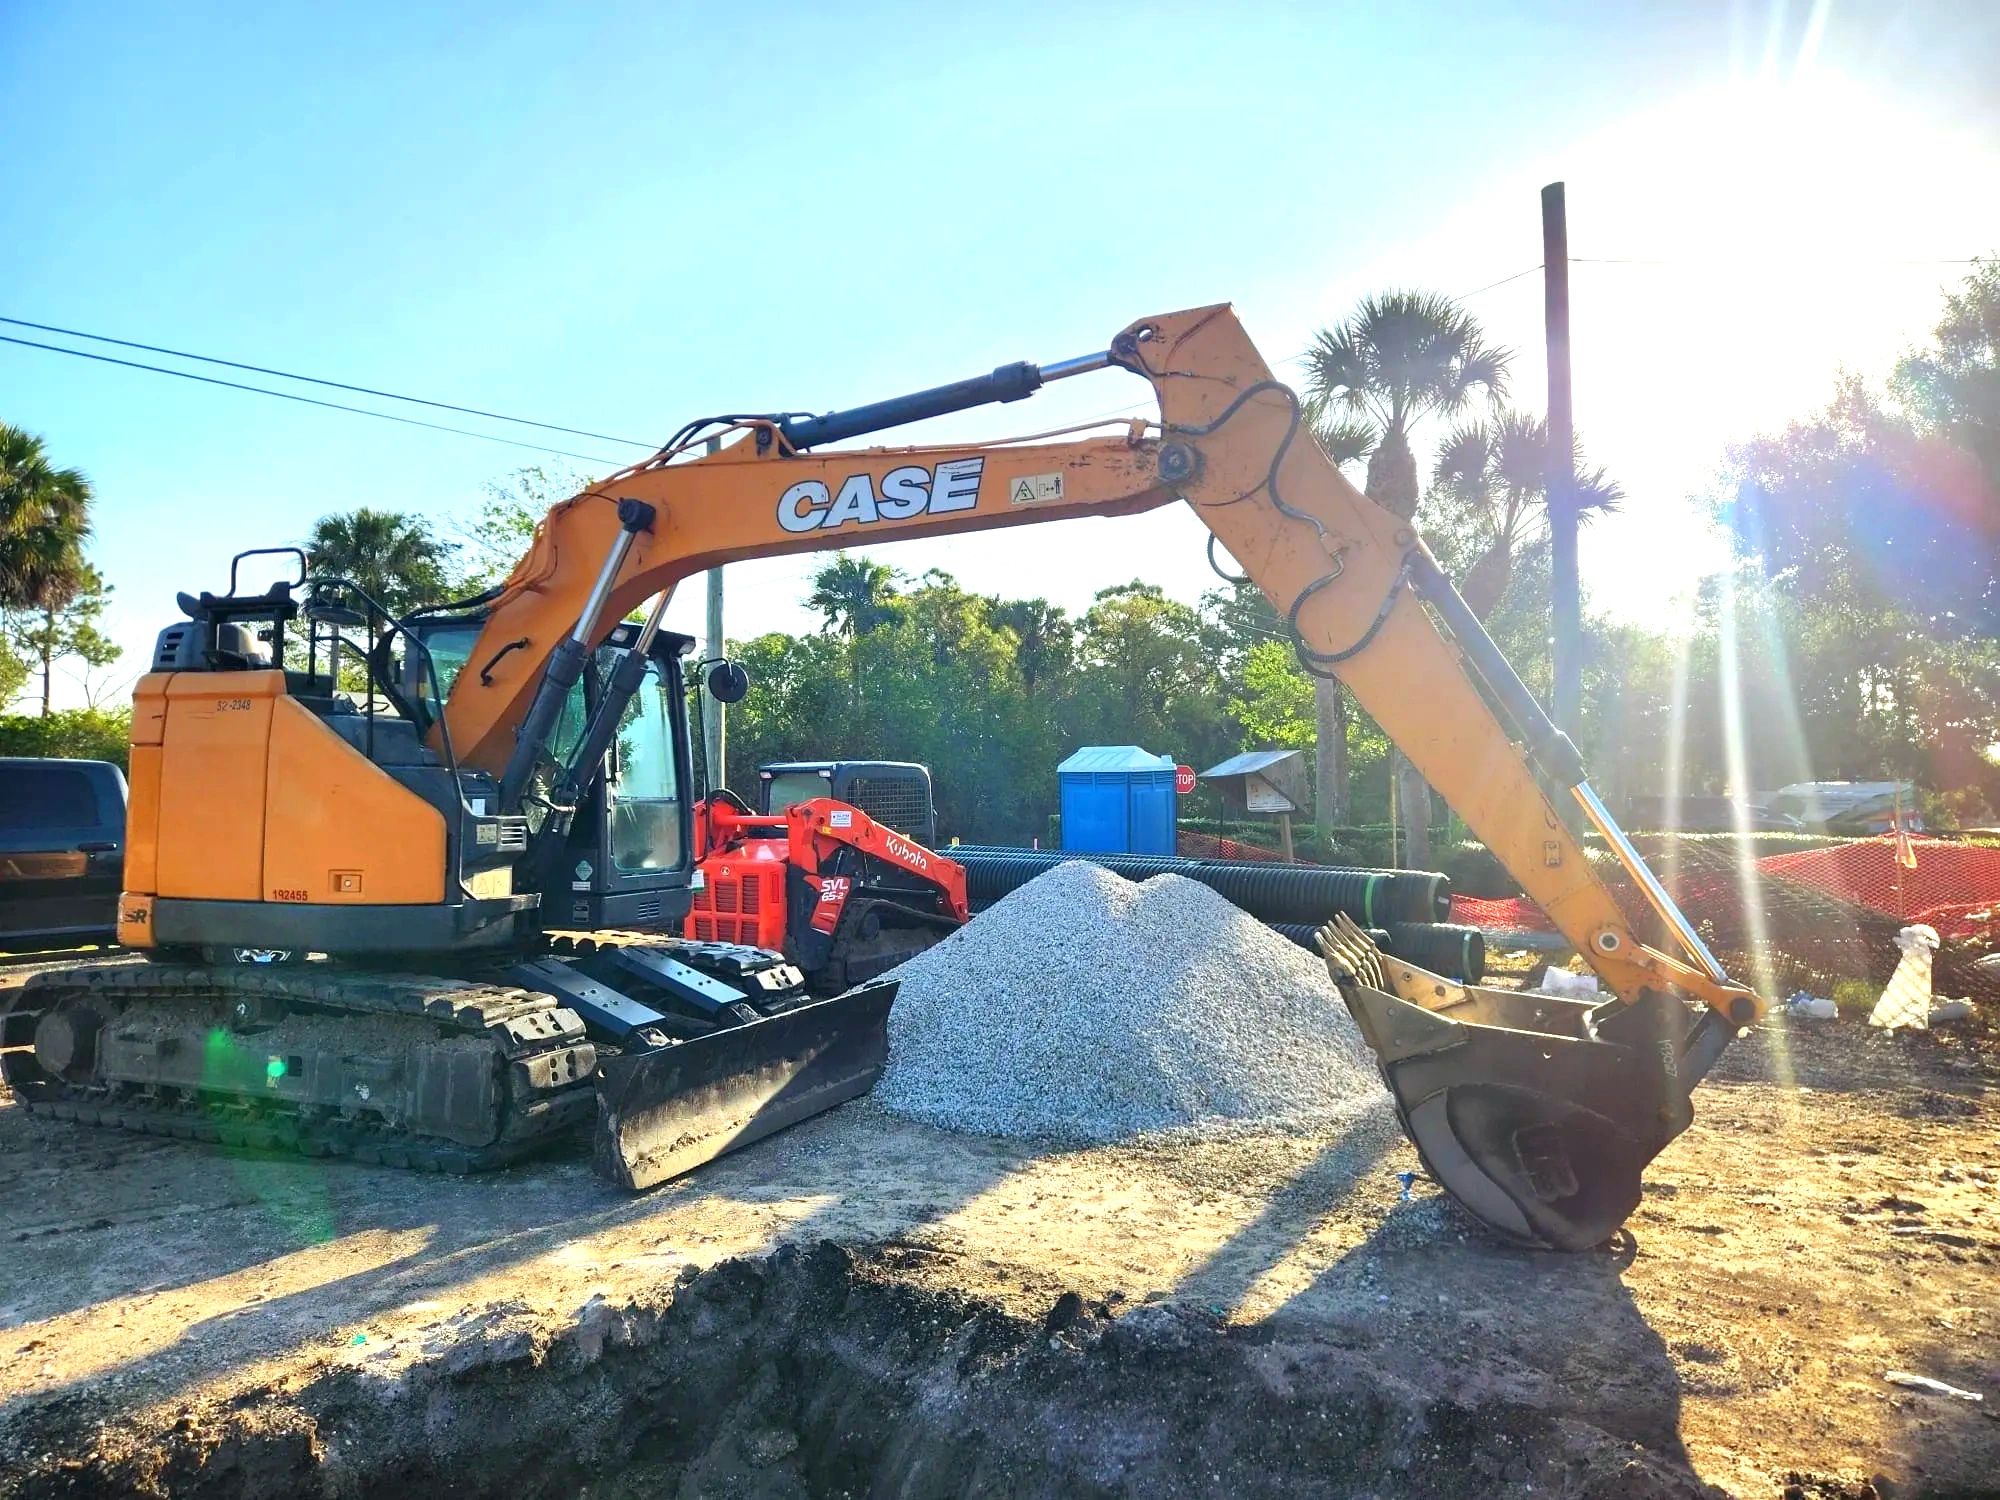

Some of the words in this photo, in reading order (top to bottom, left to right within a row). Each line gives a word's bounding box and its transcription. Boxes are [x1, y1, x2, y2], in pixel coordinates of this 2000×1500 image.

[777, 456, 985, 533] CASE
[1176, 774, 1194, 785] TOP
[886, 836, 927, 870] Kubota
[821, 879, 849, 893] SVL
[272, 889, 308, 901] 192455
[821, 892, 845, 902] 65-2
